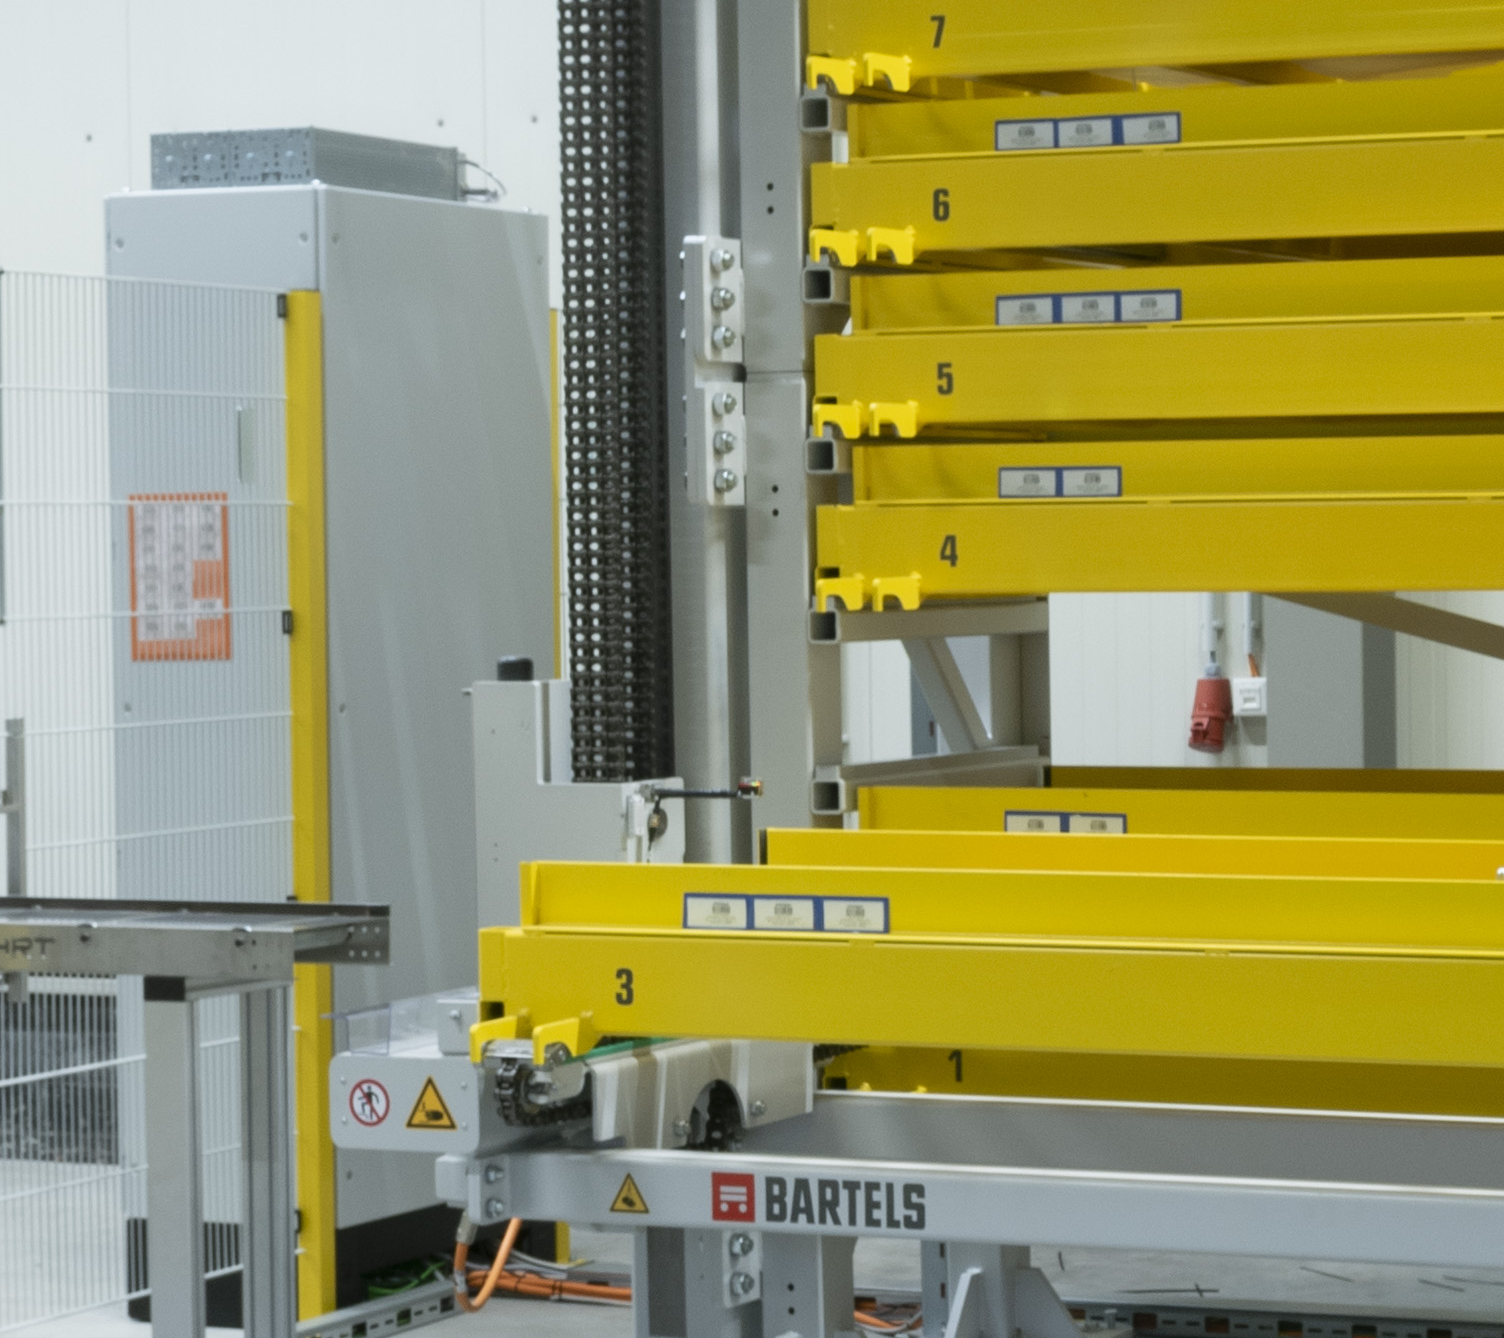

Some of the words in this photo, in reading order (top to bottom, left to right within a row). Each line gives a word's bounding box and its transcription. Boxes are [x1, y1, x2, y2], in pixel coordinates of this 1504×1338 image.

[930, 14, 946, 48] 7
[932, 188, 950, 222] 6
[937, 362, 954, 396] 5
[940, 534, 958, 567] 4
[615, 968, 634, 1006] 3
[948, 1049, 963, 1082] 1
[765, 1177, 926, 1230] BARTELS
